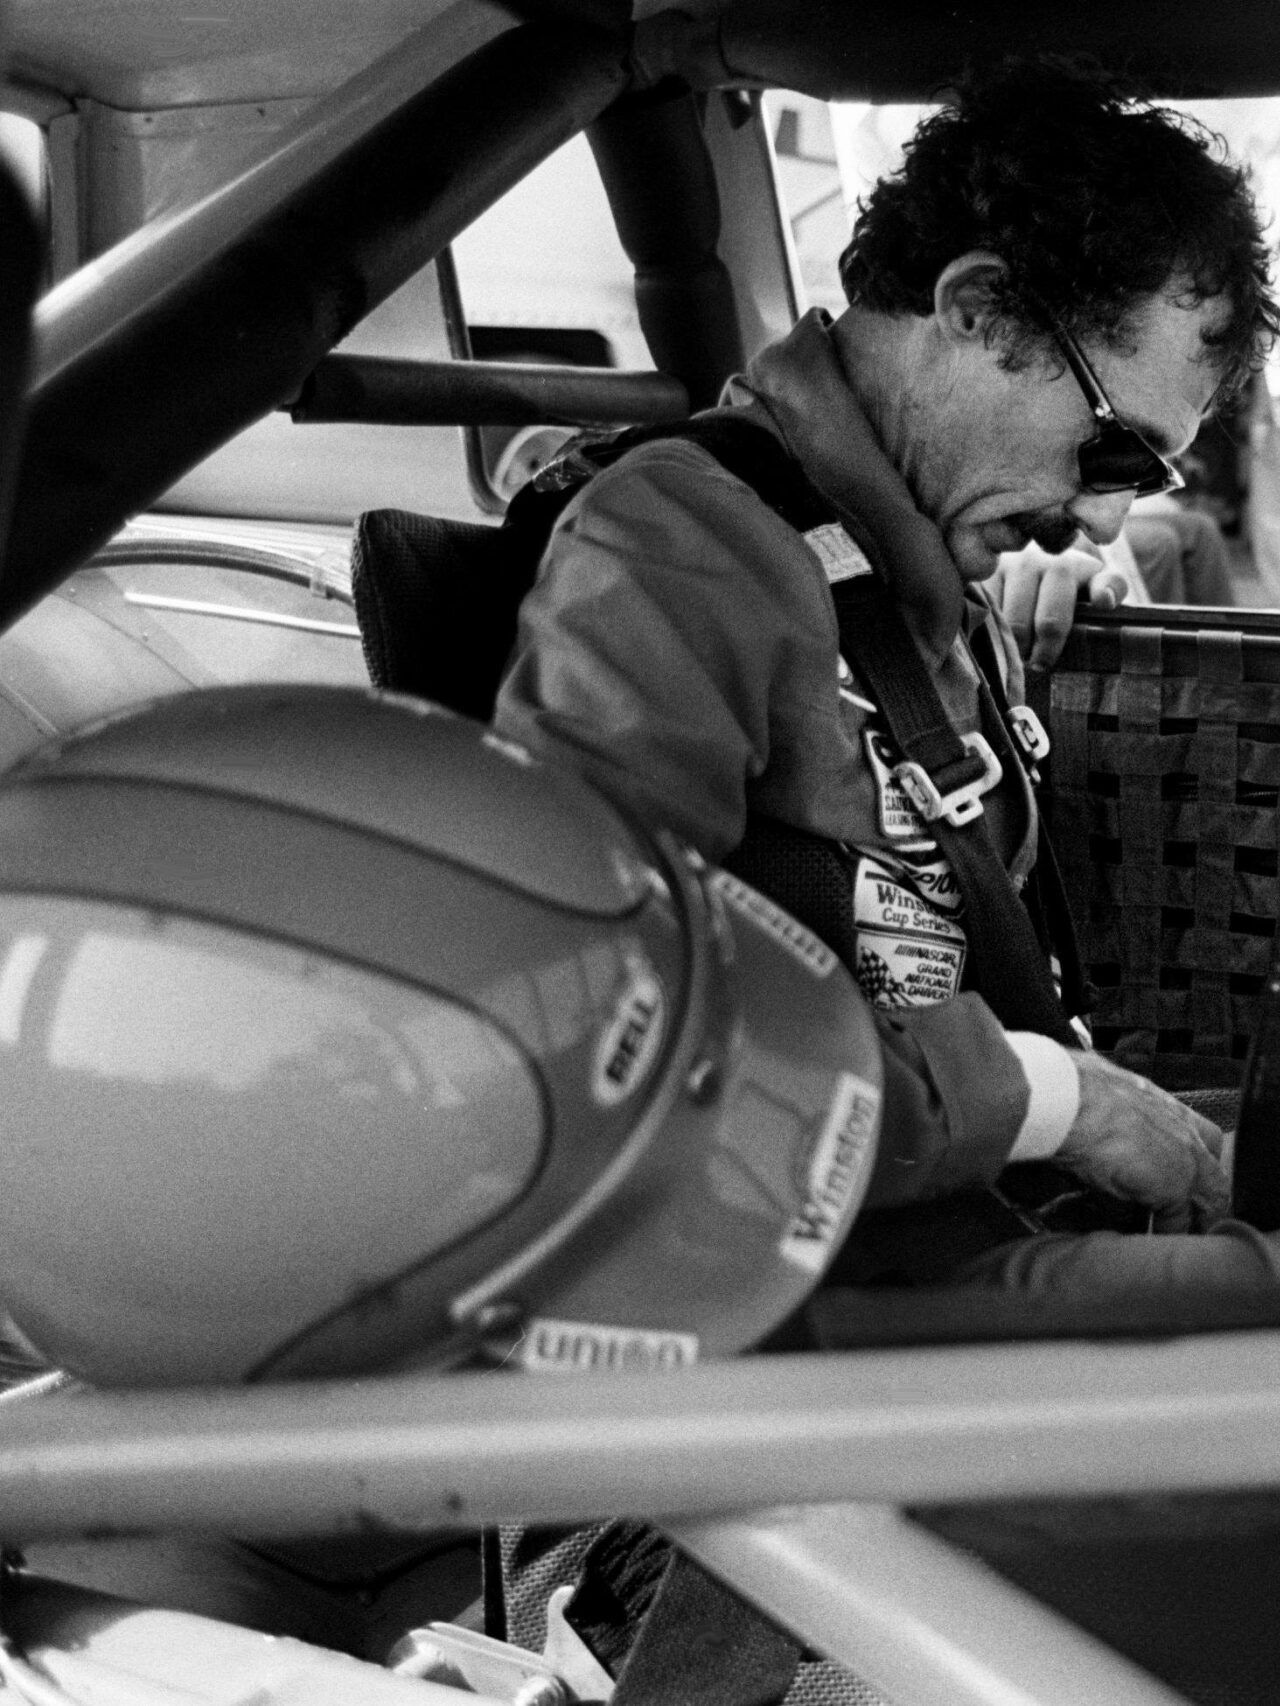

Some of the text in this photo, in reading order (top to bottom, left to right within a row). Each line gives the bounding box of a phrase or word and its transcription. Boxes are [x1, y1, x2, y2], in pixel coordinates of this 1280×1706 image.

[876, 882, 938, 915] Wins
[882, 907, 952, 934] Cup Series
[918, 948, 957, 969] NASCAR
[917, 963, 952, 978] GRAND
[904, 973, 953, 990] NATIONAL
[907, 985, 951, 1000] DRIVERS
